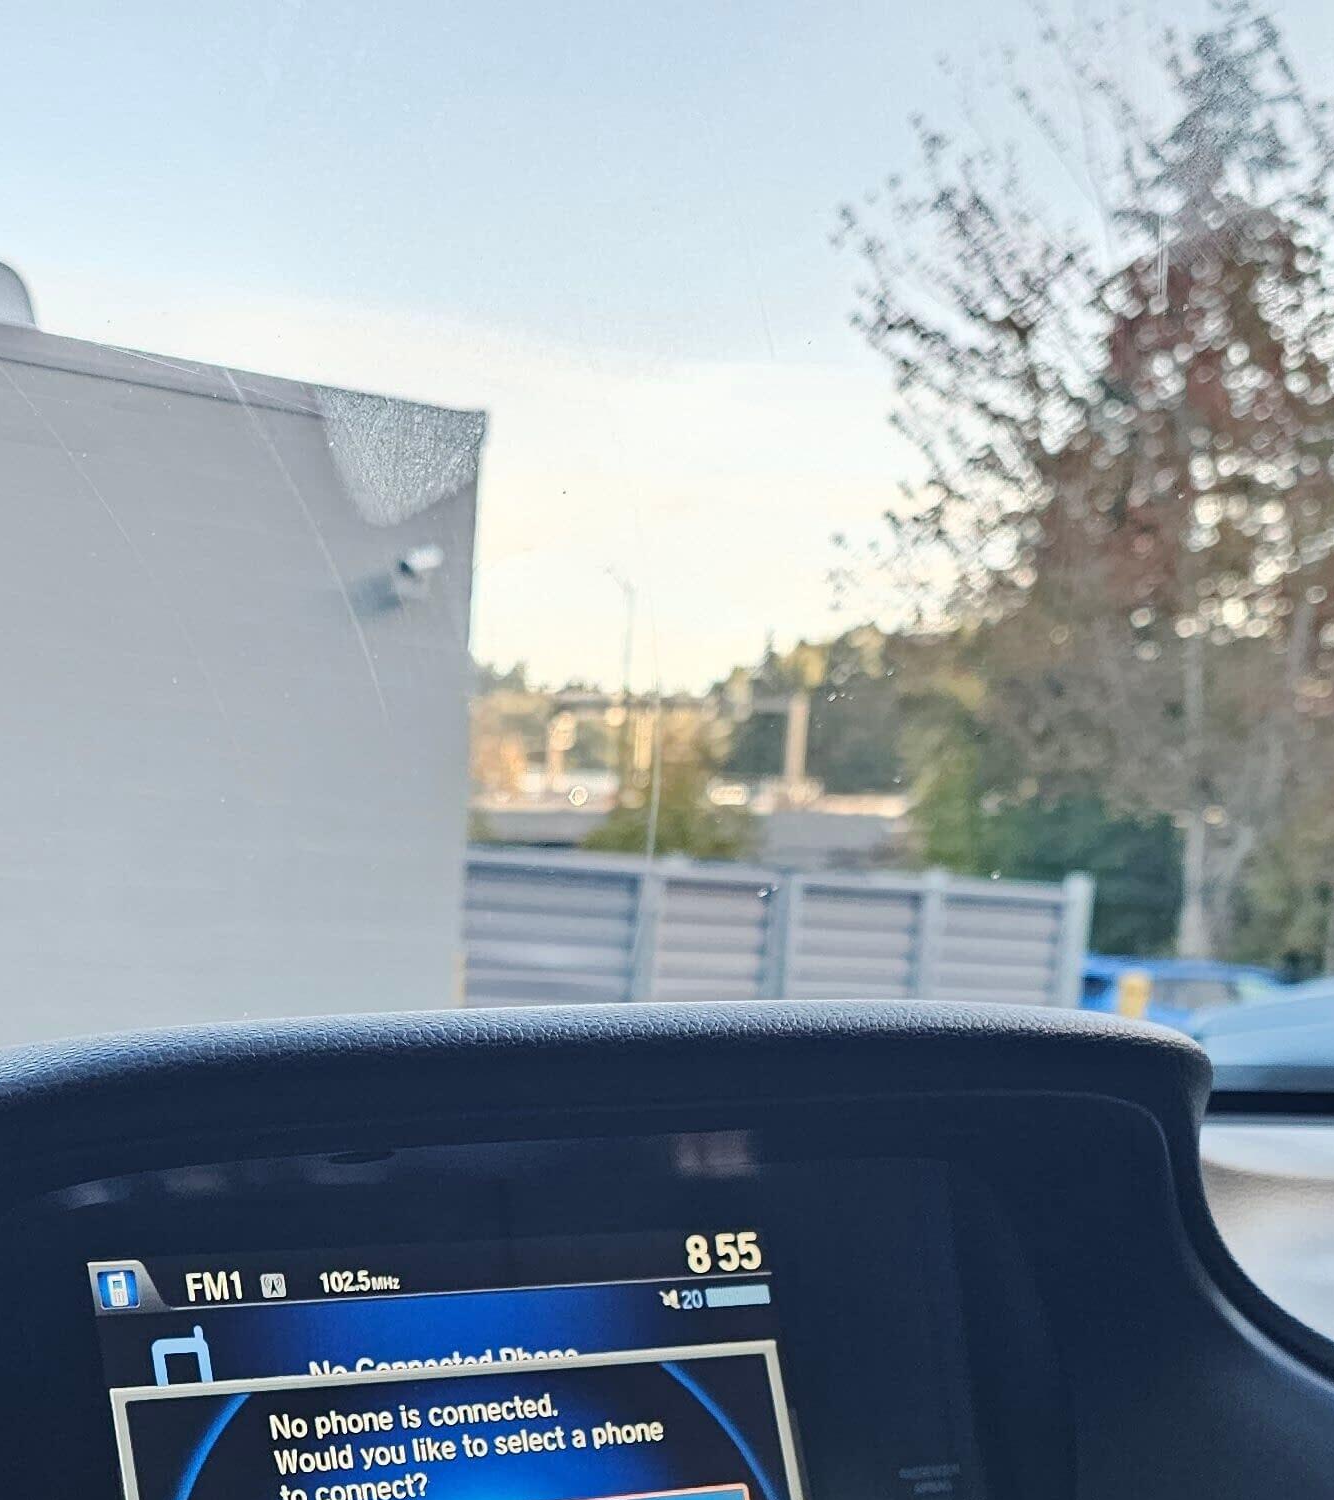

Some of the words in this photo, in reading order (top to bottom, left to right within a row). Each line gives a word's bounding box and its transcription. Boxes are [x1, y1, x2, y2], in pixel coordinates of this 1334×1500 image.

[183, 1268, 245, 1304] FM1
[681, 1288, 704, 1311] 20
[269, 1413, 309, 1442] No
[315, 1408, 395, 1440] phone
[399, 1404, 423, 1430] is
[427, 1393, 561, 1428] connected.
[273, 1443, 355, 1476] Would
[361, 1440, 407, 1471] you
[411, 1436, 458, 1463] like
[463, 1431, 489, 1460] to
[494, 1425, 568, 1456] select
[571, 1424, 589, 1449] a
[593, 1419, 666, 1451] phone
